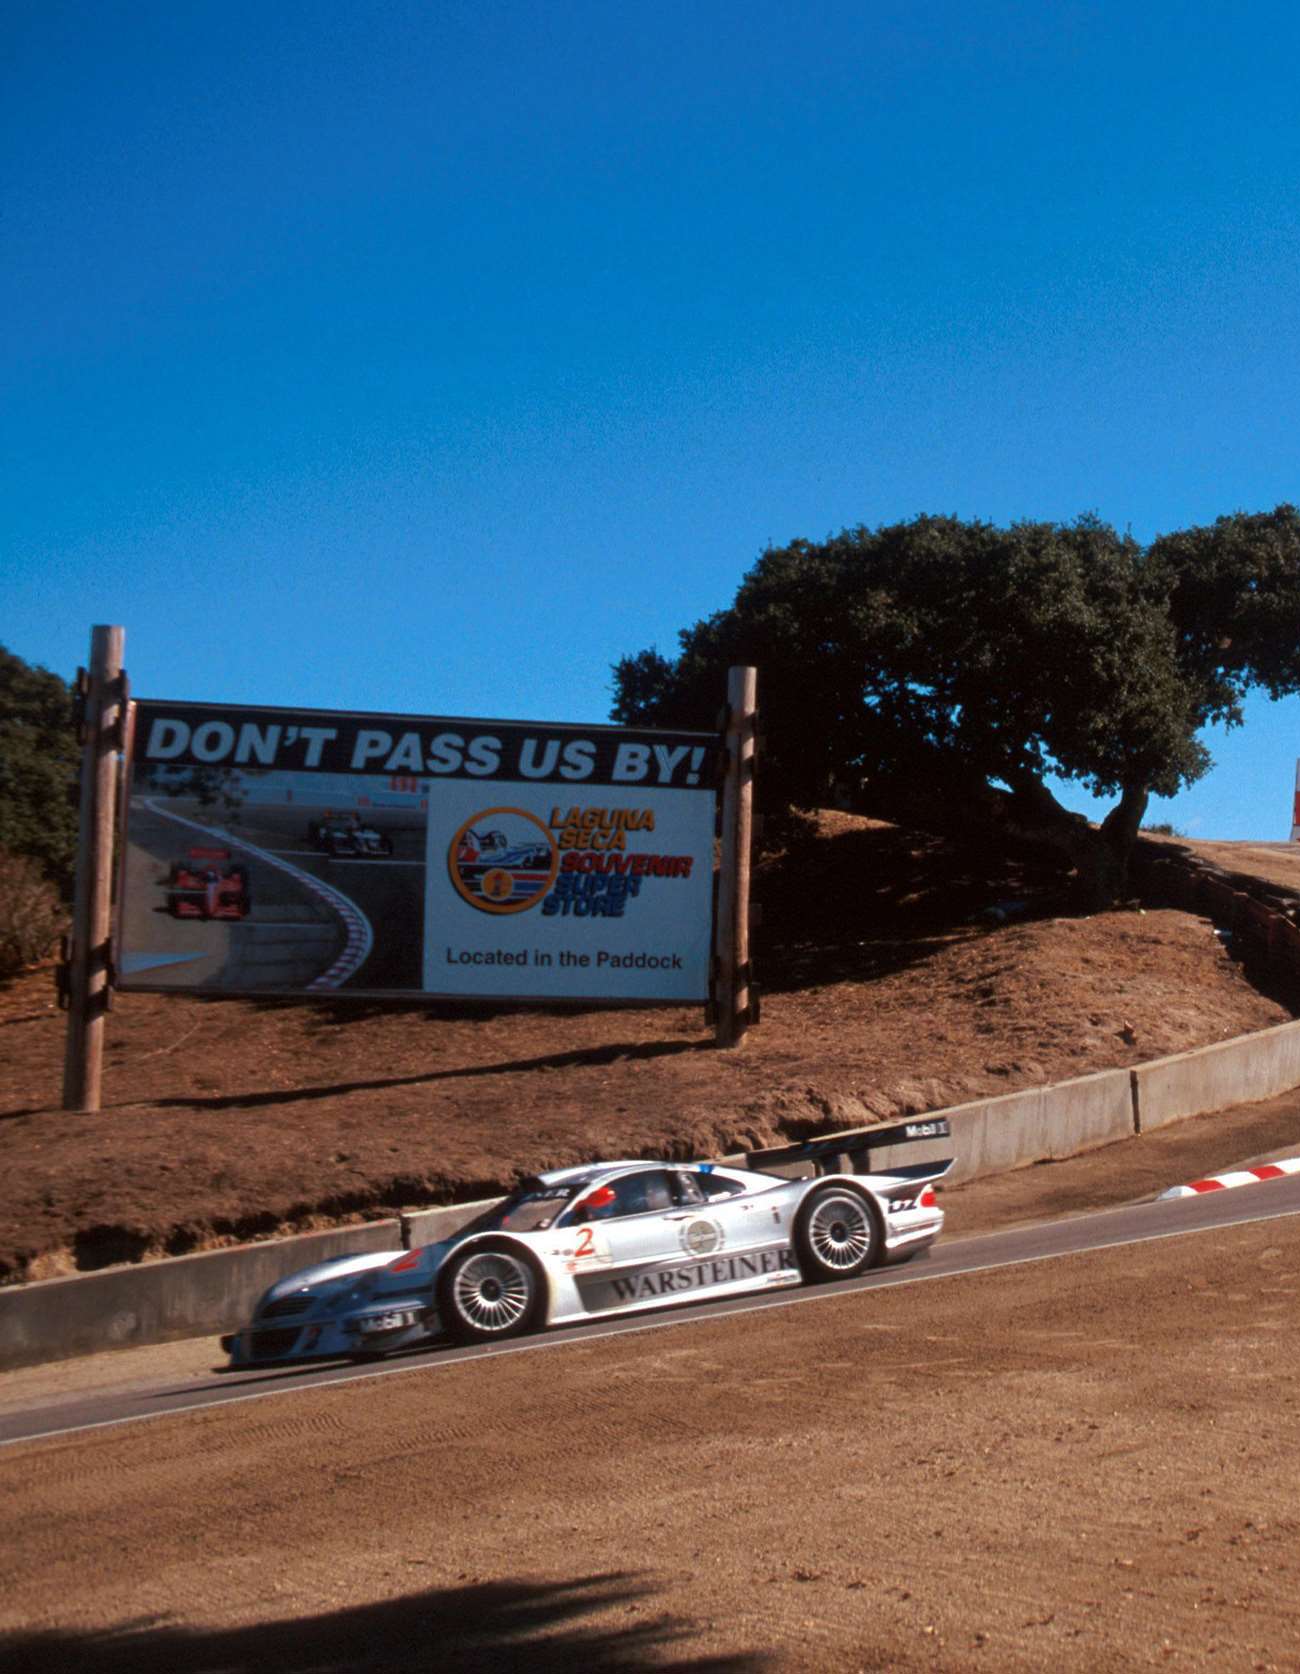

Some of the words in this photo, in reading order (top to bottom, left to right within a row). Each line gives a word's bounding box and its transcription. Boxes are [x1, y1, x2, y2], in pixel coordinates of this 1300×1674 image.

[146, 718, 337, 768] DON'T
[351, 729, 502, 777] PASS
[518, 738, 597, 781] US
[611, 743, 705, 786] BY!
[549, 807, 657, 833] LAGUNA
[557, 828, 628, 851] SECA
[558, 850, 695, 879] SOUVENIR
[552, 872, 643, 899] SUPER
[539, 895, 627, 918] STORE
[446, 948, 529, 967] Located
[534, 951, 554, 967] in
[559, 951, 592, 968] the
[596, 952, 684, 971] Paddock
[905, 1122, 937, 1138] Mobil
[576, 1228, 596, 1257] 2
[610, 1247, 796, 1300] WARSTEINER
